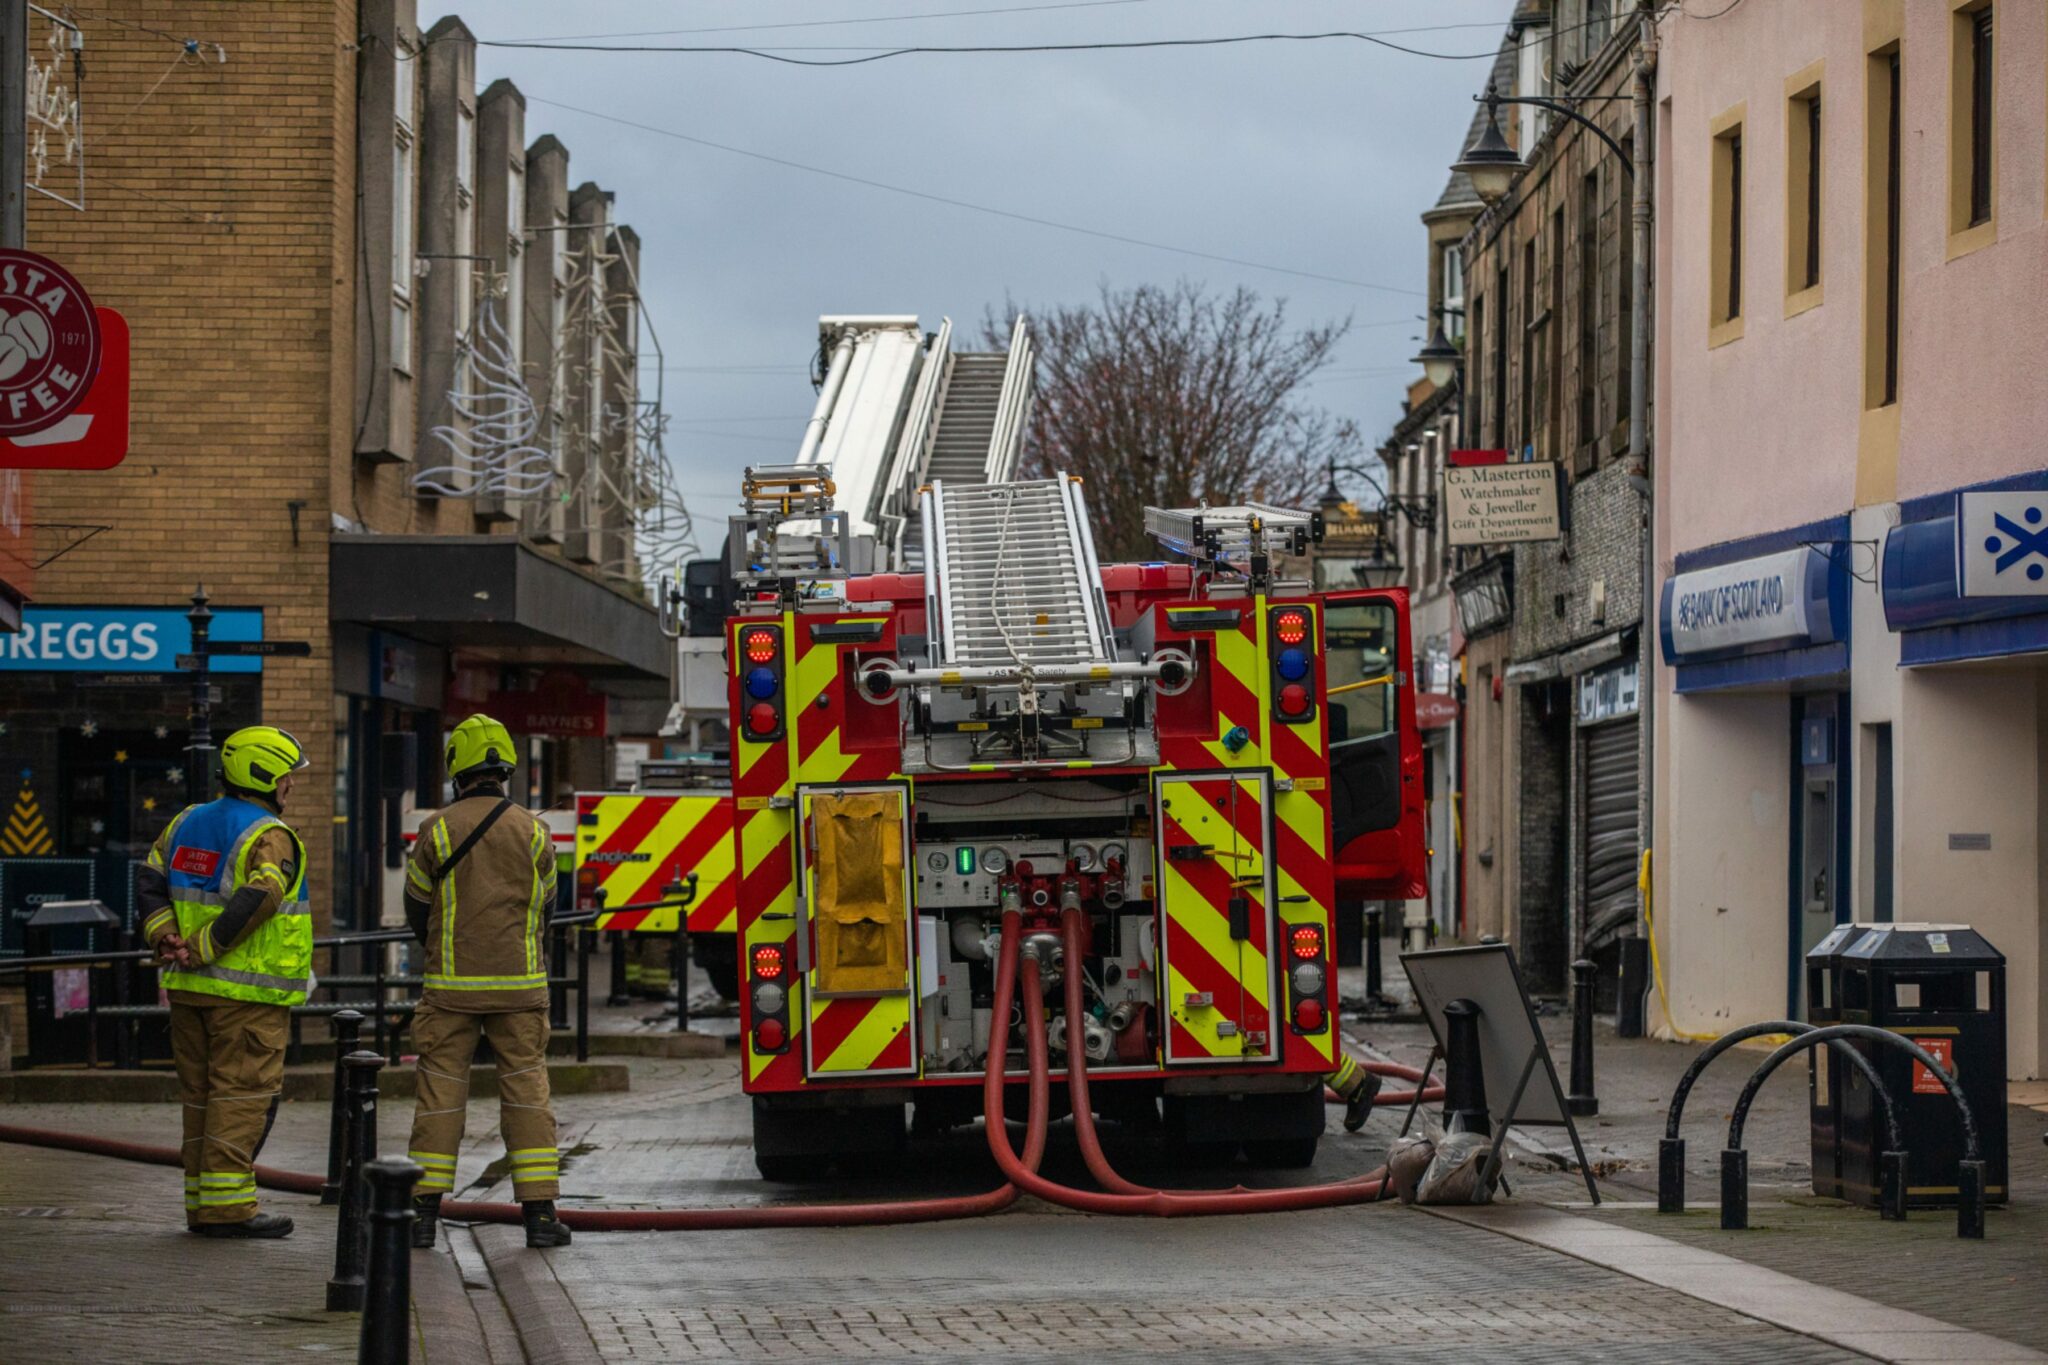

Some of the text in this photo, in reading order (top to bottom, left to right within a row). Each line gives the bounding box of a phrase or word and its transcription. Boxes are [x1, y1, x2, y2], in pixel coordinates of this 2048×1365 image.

[61, 332, 86, 346] 1971
[0, 363, 79, 419] FEE
[1448, 467, 1552, 484] G. Masterton
[1460, 484, 1541, 500] Watchmaker
[1468, 500, 1537, 516] & Jeweller
[1452, 516, 1553, 530] Gift Department
[1480, 529, 1531, 540] Upstairs
[1691, 575, 1783, 631] BANK OF SCOTLAND
